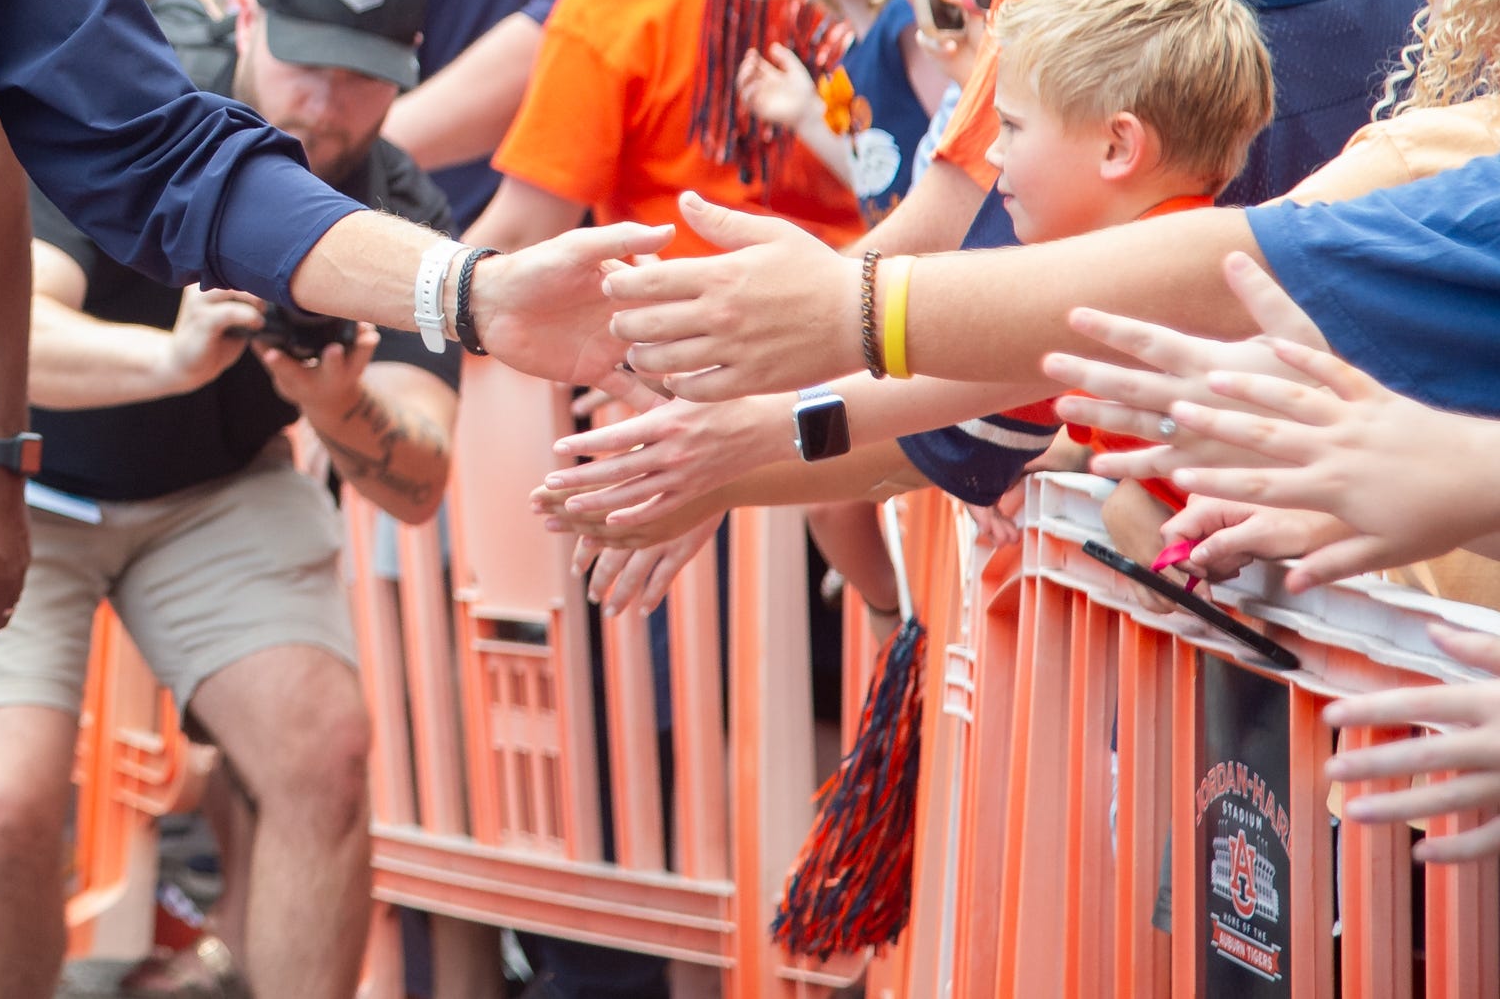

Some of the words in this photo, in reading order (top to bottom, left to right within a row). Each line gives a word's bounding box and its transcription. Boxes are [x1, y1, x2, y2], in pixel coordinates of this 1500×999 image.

[1222, 800, 1262, 831] STADIUM
[1223, 912, 1240, 929] HOME
[1242, 922, 1251, 934] OF
[1254, 927, 1267, 943] THE
[1219, 932, 1246, 957] AUBURN
[1246, 946, 1273, 971] TIGERS
